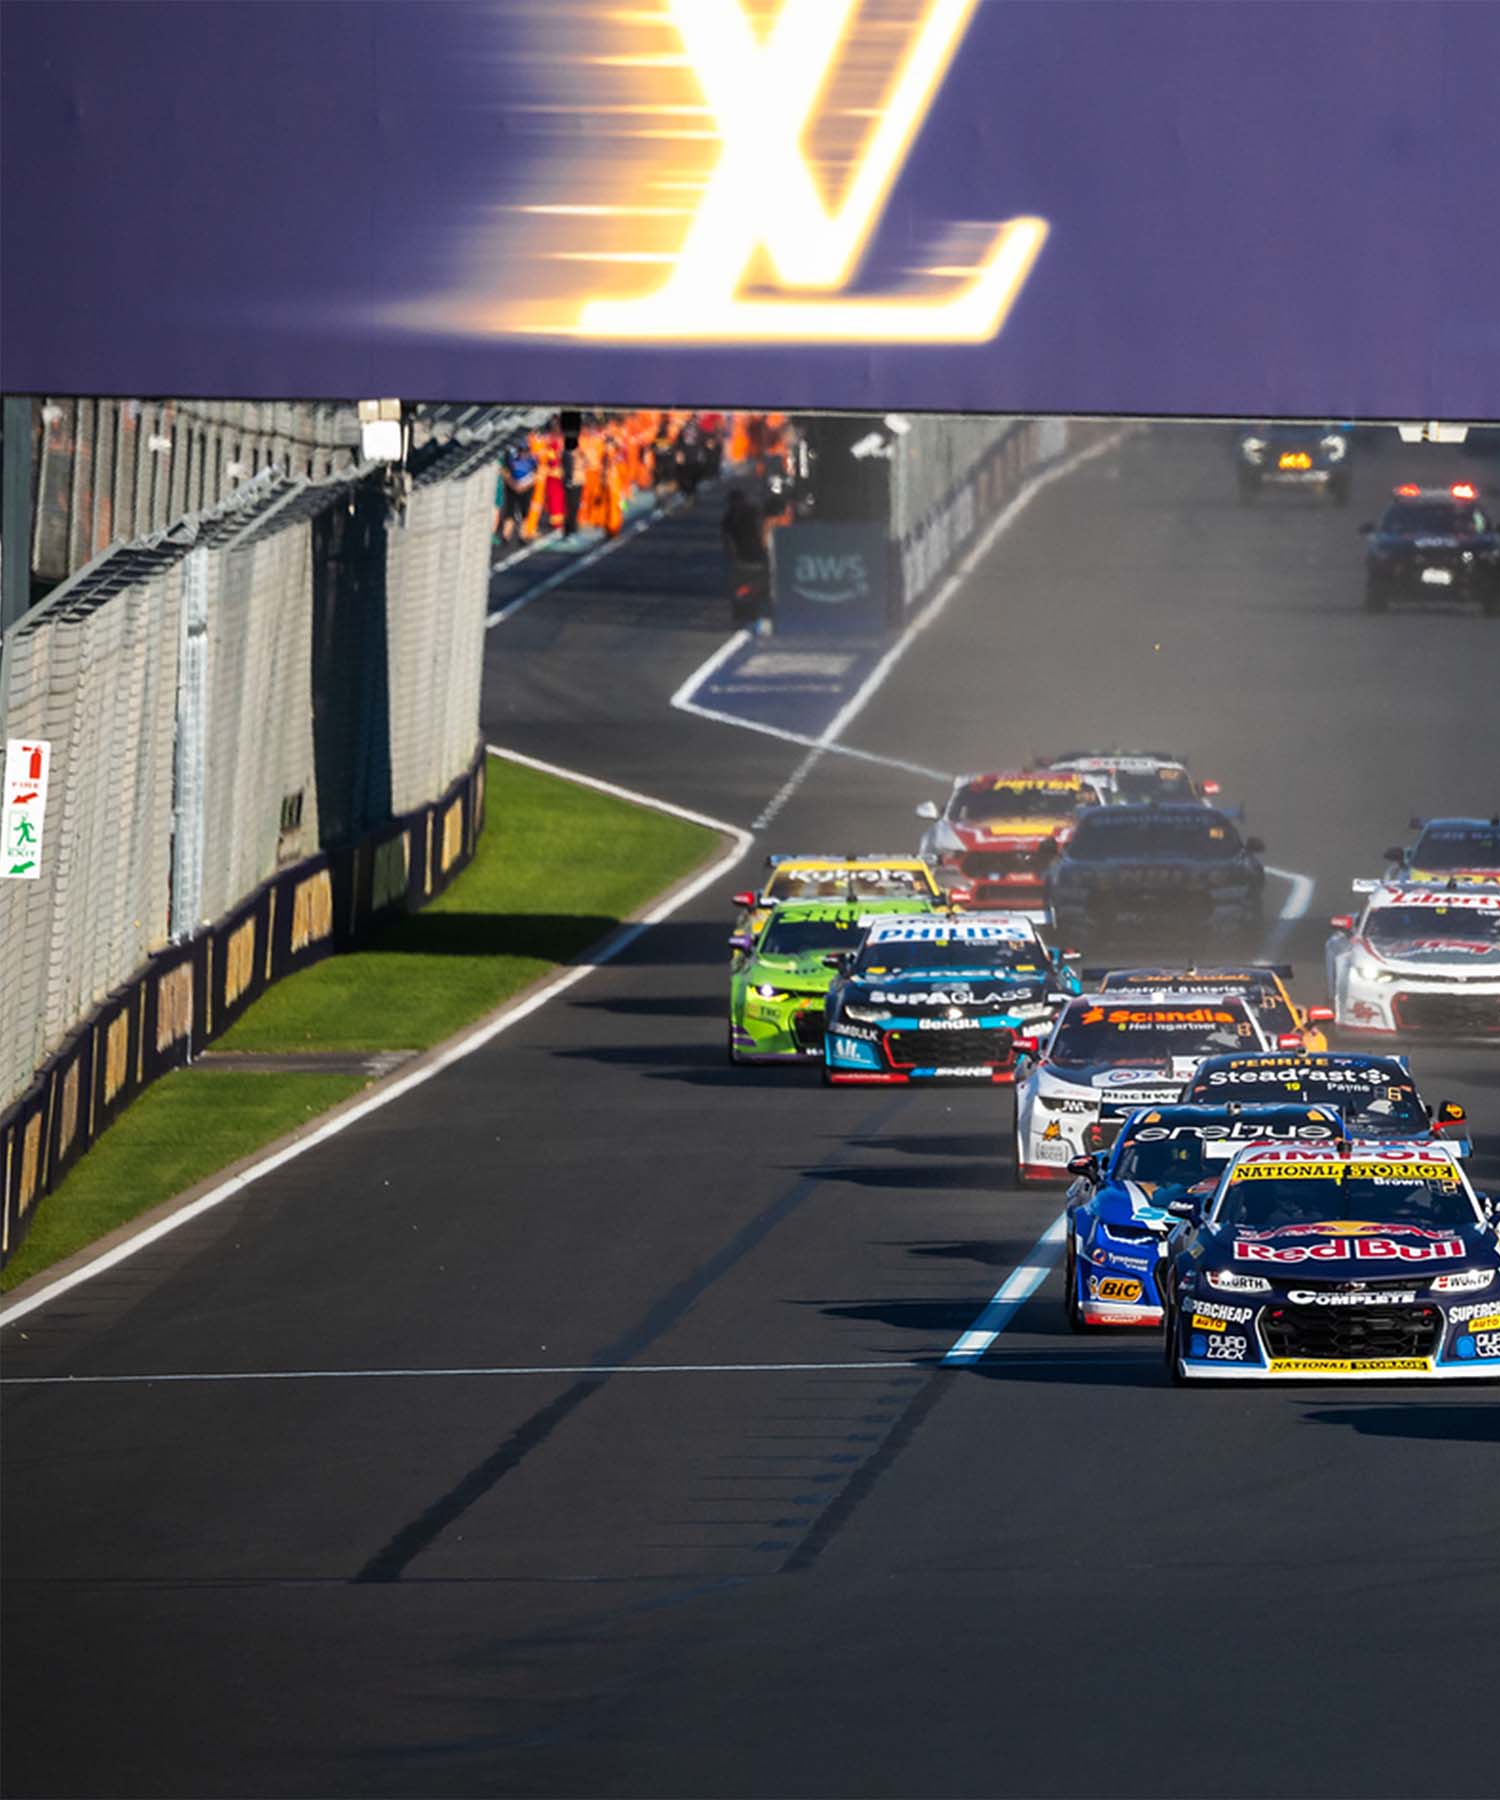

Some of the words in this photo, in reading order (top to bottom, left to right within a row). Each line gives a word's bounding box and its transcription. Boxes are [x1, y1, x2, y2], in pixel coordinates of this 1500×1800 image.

[796, 555, 866, 581] aws
[879, 928, 1026, 941] PHILIPS
[870, 988, 1032, 1005] SUPAGLASS
[1107, 1009, 1235, 1023] Scandia
[1231, 1058, 1329, 1069] PENRITE
[1209, 1067, 1356, 1085] Steadfast
[1327, 1083, 1370, 1093] Payne
[1237, 1165, 1340, 1178] NATIONAL
[1348, 1165, 1453, 1178] STORAGE
[1374, 1178, 1424, 1187] Brown
[1233, 1239, 1350, 1263] Red
[1354, 1239, 1467, 1262] Bull
[1287, 1289, 1417, 1305] COMPLETE
[1181, 1295, 1253, 1325] SUPERCHEAP
[1195, 1317, 1223, 1329] AUTO
[1471, 1319, 1500, 1329] AUTO
[1208, 1335, 1248, 1349] QUAD
[1206, 1348, 1247, 1361] LOCK
[1272, 1359, 1348, 1371] NATIONAL
[1351, 1361, 1429, 1371] STORAGE
